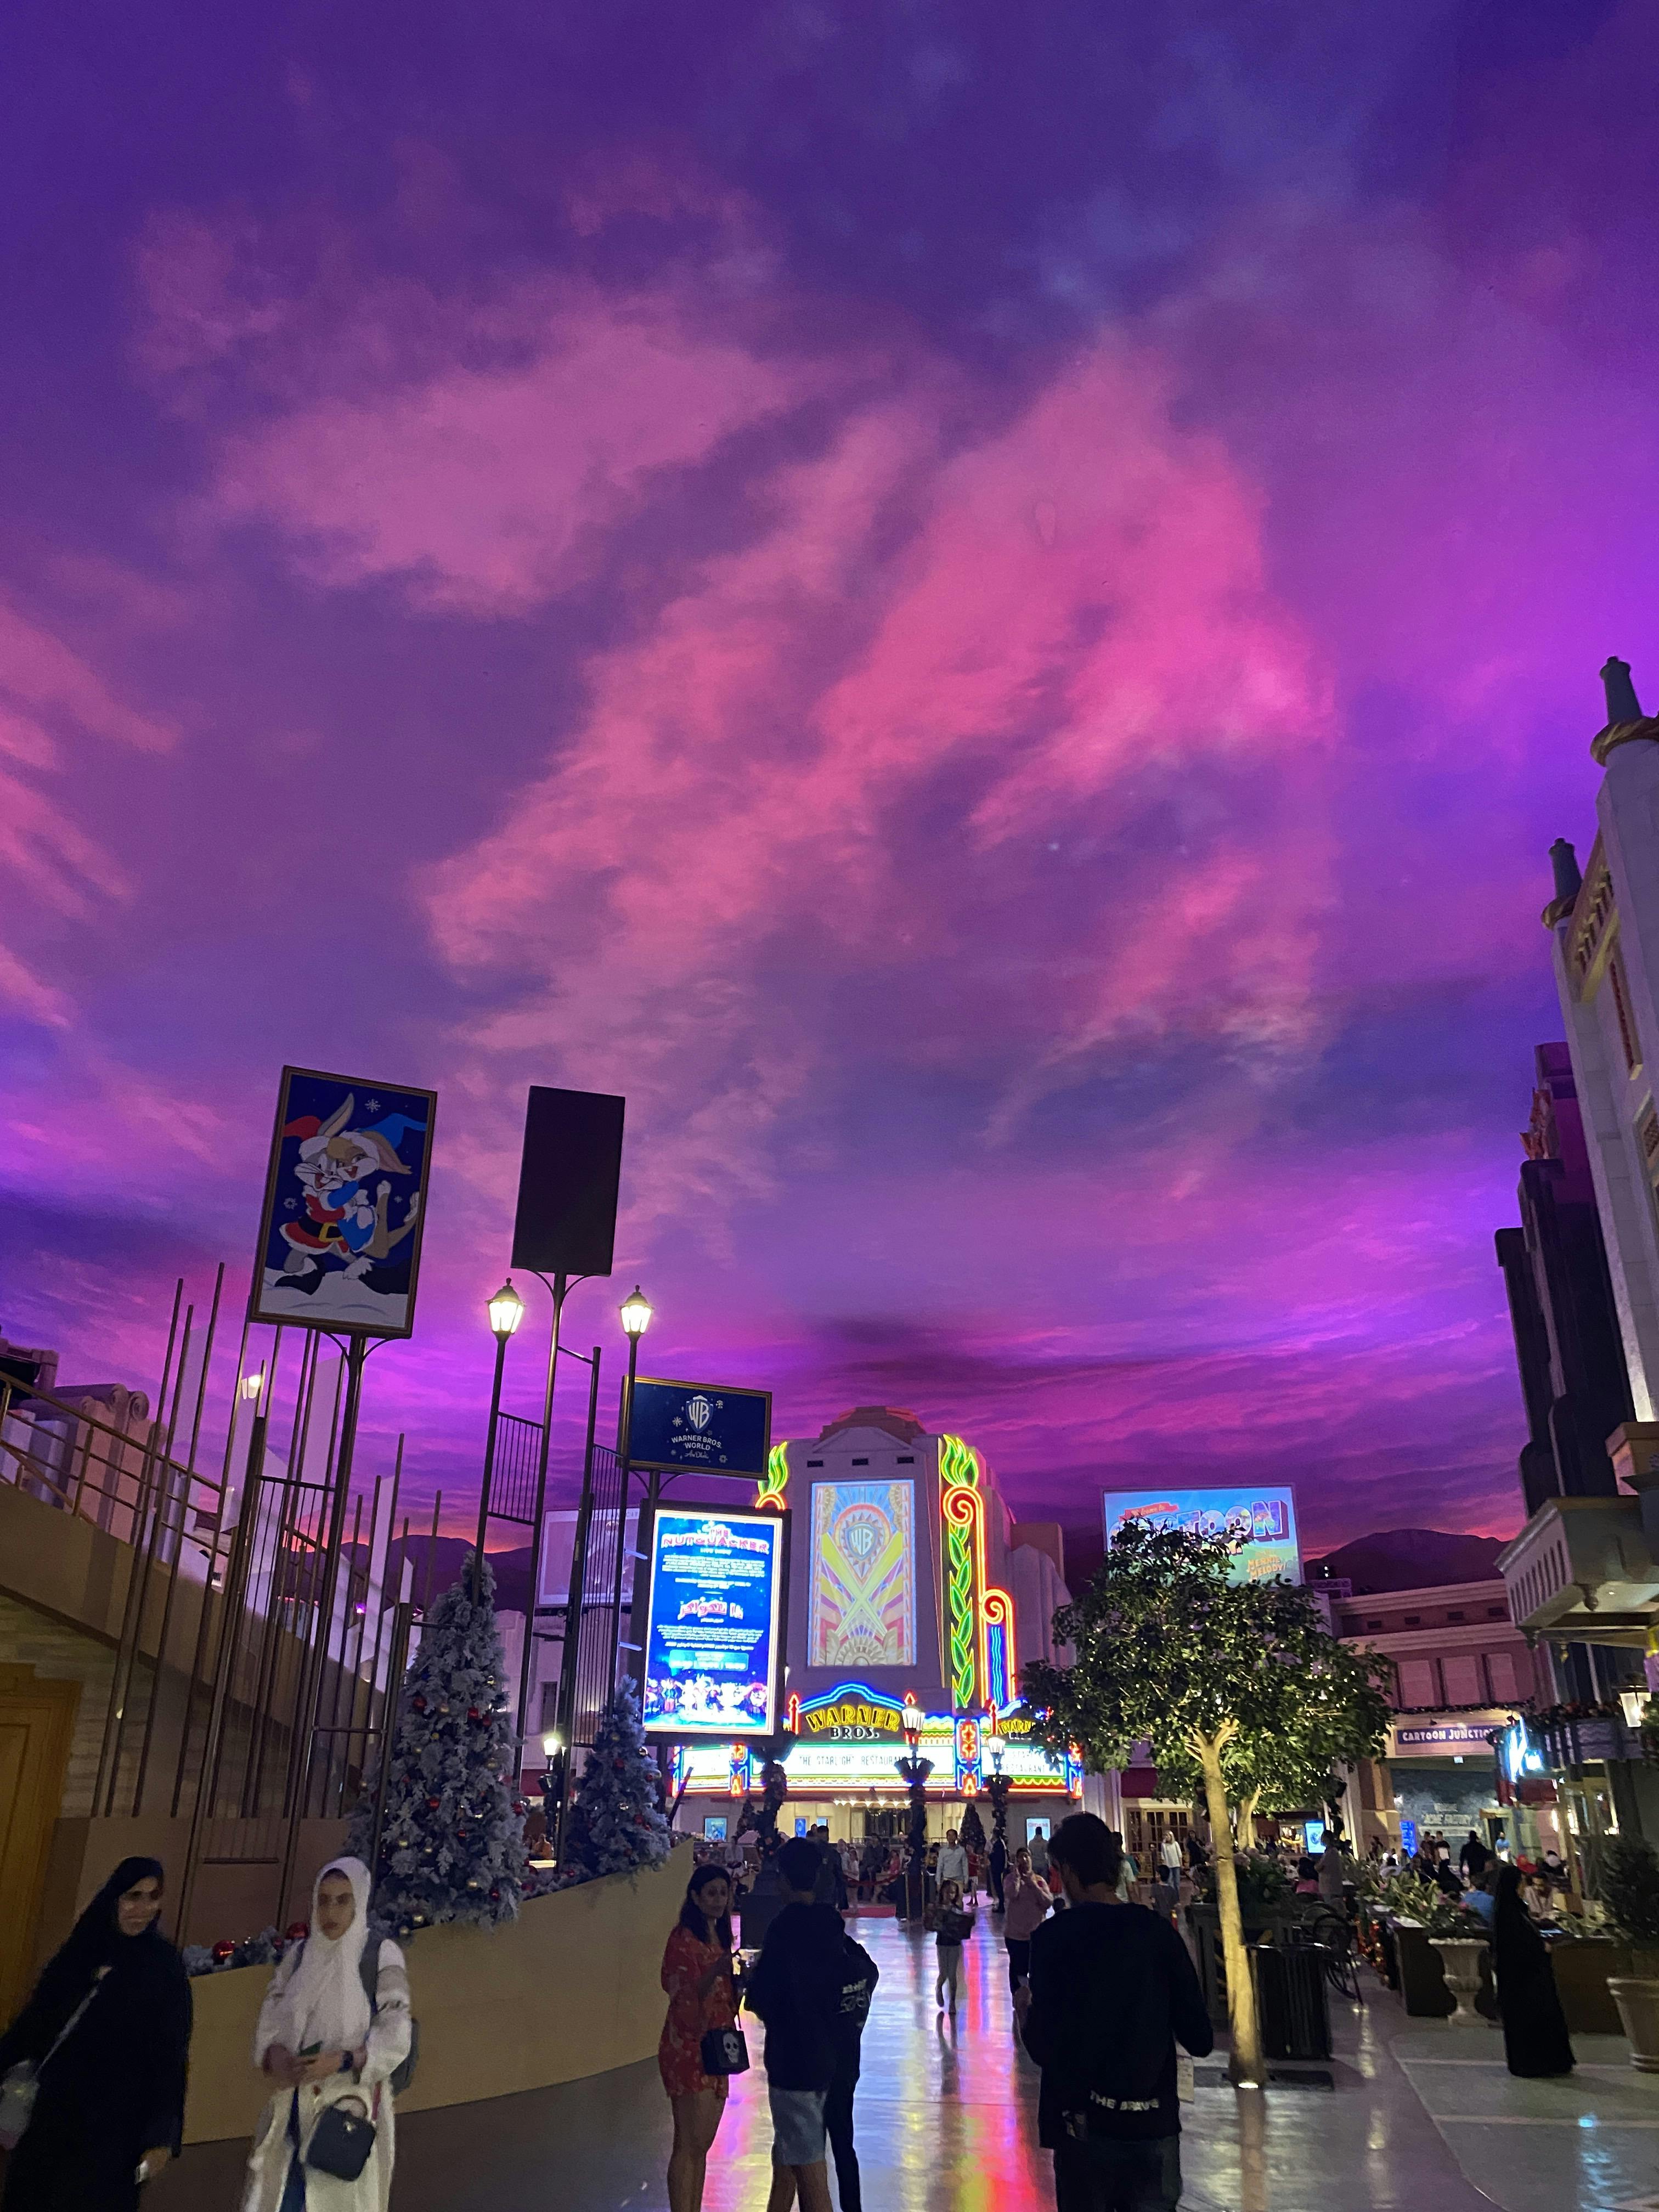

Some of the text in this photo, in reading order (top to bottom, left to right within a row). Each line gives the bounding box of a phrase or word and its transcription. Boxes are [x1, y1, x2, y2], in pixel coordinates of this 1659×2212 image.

[688, 1401, 710, 1429] WB
[671, 1435, 702, 1443] WARNER
[684, 1442, 711, 1451] WORLD
[851, 1528, 873, 1555] WB
[805, 1704, 900, 1733] WARNER
[830, 1725, 880, 1740] BROS.
[998, 1719, 1035, 1735] WARN
[1402, 1729, 1493, 1741] CARTOON JUNCTIO
[799, 1756, 811, 1765] THE
[861, 1756, 905, 1765] RESTAURA
